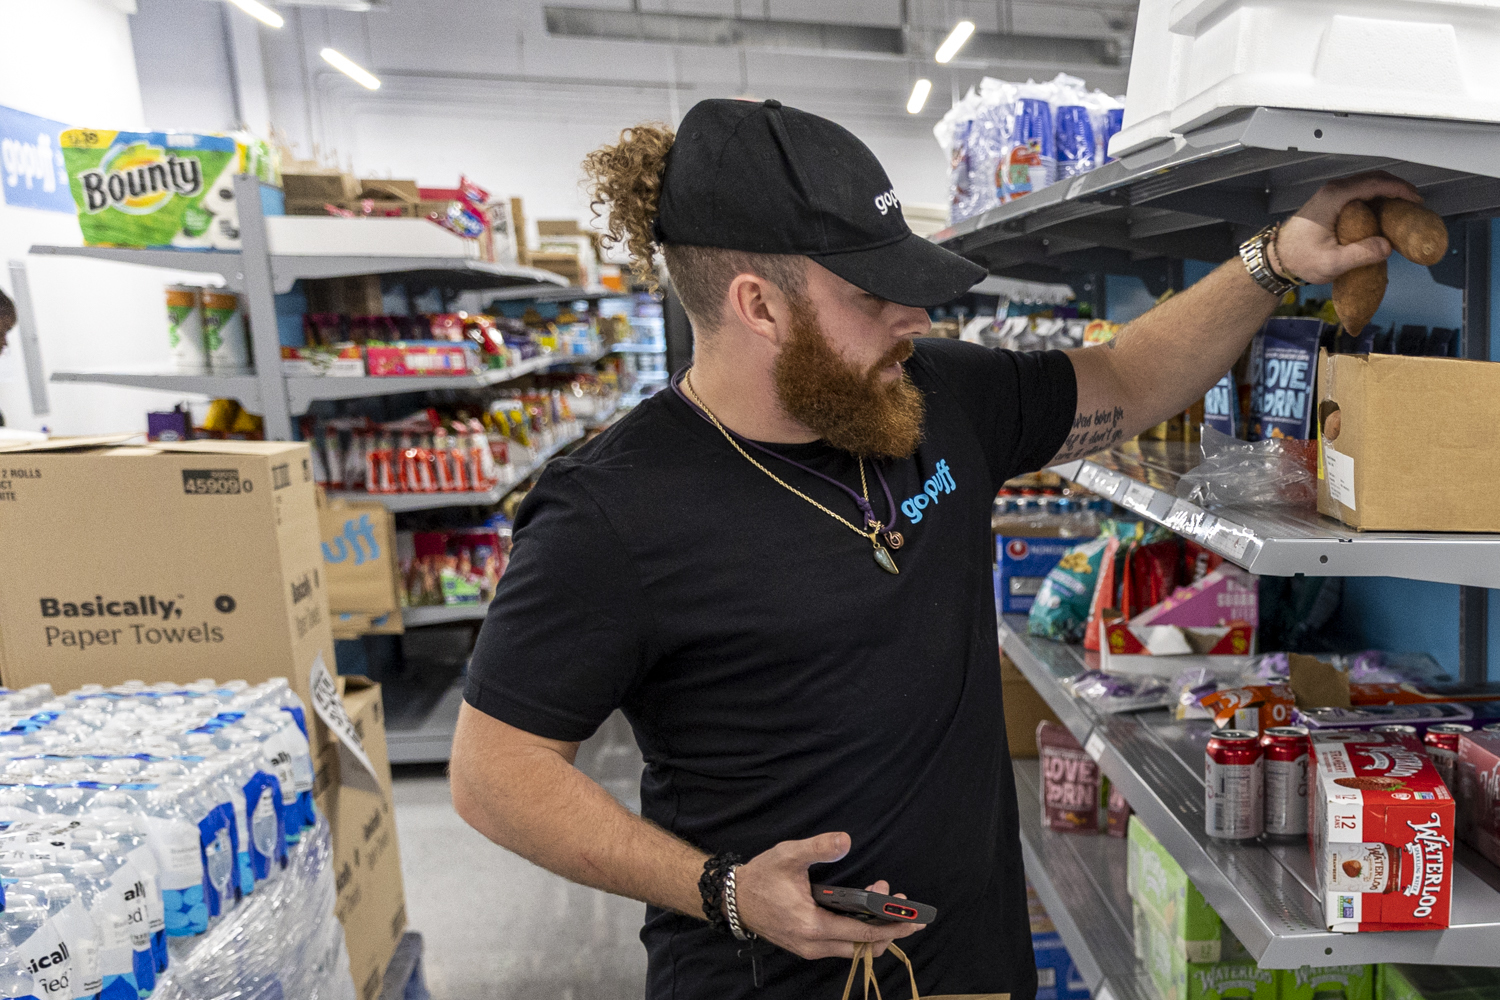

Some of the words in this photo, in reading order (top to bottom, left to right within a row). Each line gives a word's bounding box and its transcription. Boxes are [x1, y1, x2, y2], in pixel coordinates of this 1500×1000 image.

[82, 156, 201, 211] Bounty
[11, 468, 42, 479] ROLLS
[901, 459, 957, 524] gopuff
[40, 594, 183, 620] Basically,
[45, 625, 122, 650] Paper
[130, 622, 225, 645] Towels
[1341, 814, 1356, 830] 12
[1365, 844, 1385, 891] WATERLOO
[1407, 812, 1450, 918] WATERLOO
[1412, 846, 1421, 875] SPARKLING
[1412, 876, 1421, 892] WATER
[1194, 965, 1273, 995] WATERLOO
